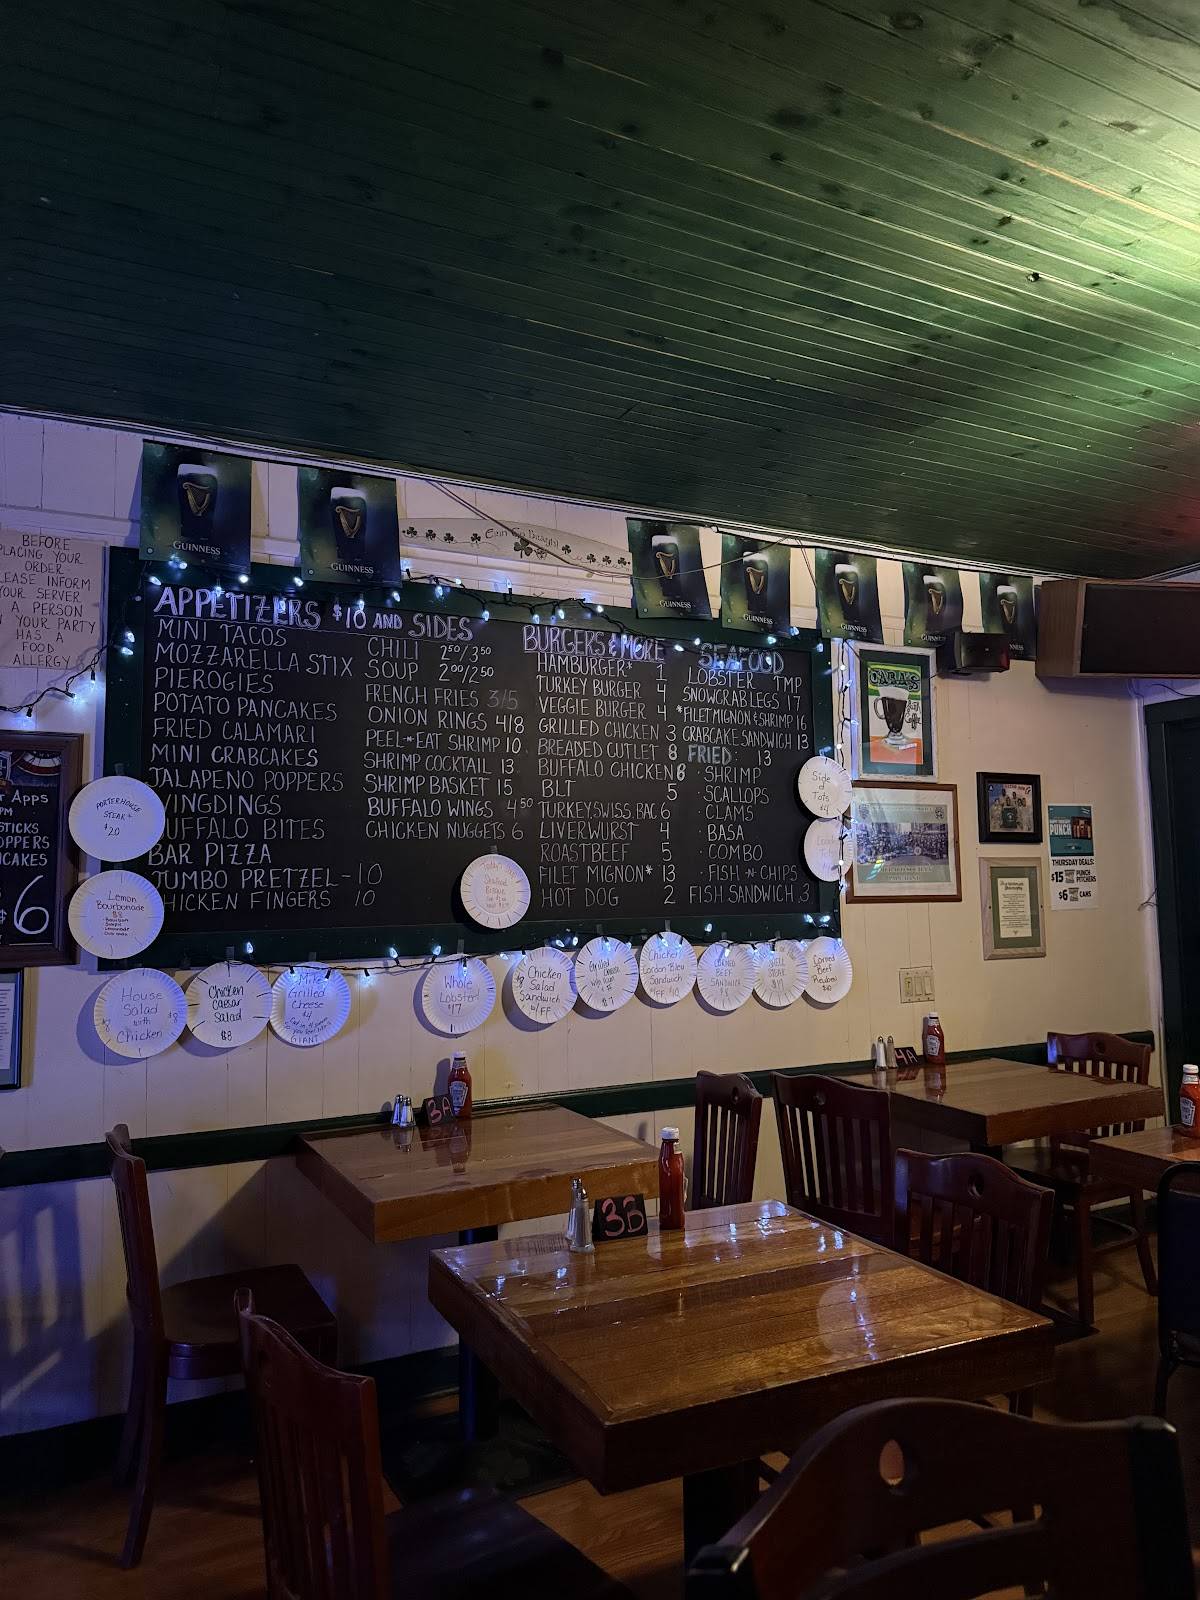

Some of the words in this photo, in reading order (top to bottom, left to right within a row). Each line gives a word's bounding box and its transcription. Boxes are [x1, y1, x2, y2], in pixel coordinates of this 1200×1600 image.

[22, 534, 71, 550] BEFORE
[172, 539, 221, 556] GUINNESS
[24, 560, 65, 575] ORDER
[53, 551, 84, 565] YOUR
[330, 562, 374, 575] GUINNESS
[47, 575, 91, 591] INFORM
[36, 588, 82, 603] SERVER
[659, 600, 692, 609] GUINNESS
[11, 601, 20, 613] A
[32, 601, 83, 618] PERSON
[153, 586, 321, 631] APPETIZERS
[372, 612, 403, 630] AND
[407, 612, 474, 642] SIDES
[15, 614, 51, 630] YOUR
[57, 618, 96, 635] PARTY
[742, 613, 774, 626] GUINNESS
[16, 629, 42, 641] HAS
[56, 632, 64, 643] A
[157, 619, 207, 642] MINI
[219, 623, 287, 647] TACOS
[522, 624, 606, 656] BURGERS
[22, 641, 55, 654] FOOD
[367, 636, 419, 660] CHILI
[12, 654, 71, 670] ALLERGY
[154, 641, 300, 673] MOZZARELLA
[305, 653, 353, 677] STIX
[364, 659, 419, 681] SOUP
[154, 667, 274, 694] PIEROGIES
[536, 674, 587, 696] TURKEY
[592, 679, 642, 699] BURGER
[656, 683, 666, 703] 4
[687, 666, 756, 690] LOBSTER
[773, 675, 803, 694] TMP
[365, 683, 427, 704] FRENCH
[434, 687, 479, 708] FRIES
[787, 695, 801, 711] 17
[153, 692, 230, 715] POTATO
[237, 697, 337, 722] PANCAKES
[538, 696, 590, 716] VEGGIE
[595, 699, 647, 720] BURGER
[657, 704, 667, 721] 4
[367, 706, 428, 726] ONION
[437, 710, 488, 731] RINGS
[713, 708, 751, 725] MIGNON
[759, 712, 793, 728] SHRIMP
[796, 714, 807, 731] 16
[152, 718, 212, 739] FRIED
[222, 721, 315, 743] CALAMARI
[538, 718, 600, 736] GRILLED
[604, 720, 660, 740] CHICKEN
[665, 724, 677, 742] 3
[682, 725, 738, 747] CRABCAKE
[740, 729, 792, 751] SANDWICH
[797, 734, 809, 750] 13
[447, 733, 501, 753] SHRIMP
[506, 736, 521, 754] 10
[537, 738, 603, 758] BREADED
[606, 742, 659, 761] CUTLET
[668, 743, 678, 760] 8
[150, 743, 200, 763] MINI
[211, 745, 319, 767] CRABCAKES
[363, 751, 421, 771] SHRIMP
[425, 756, 492, 775] COCKTAIL
[501, 758, 514, 775] 13
[757, 749, 772, 766] 13
[538, 757, 604, 777] BUFFALO
[610, 761, 674, 781] CHICKEN
[703, 765, 762, 784] SHRIMP
[146, 767, 254, 789] JALAPENO
[264, 770, 344, 792] POPPERS
[362, 773, 425, 795] SHRIMP
[429, 775, 491, 797] BASKET
[497, 778, 513, 796] 15
[12, 789, 49, 807] Apps
[541, 779, 577, 798] BLT
[666, 782, 678, 801] 5
[703, 785, 770, 805] SCALLOPS
[96, 797, 143, 813] PORTERHOUSE
[367, 797, 441, 817] BUFFALO
[449, 800, 494, 818] WINGS
[660, 802, 671, 819] 6
[705, 803, 754, 822] CLAMS
[103, 810, 126, 821] STEAK
[103, 823, 120, 837] $20
[162, 816, 249, 840] UFFALO
[263, 818, 326, 840] BITES
[365, 820, 439, 840] CHICKEN
[447, 821, 505, 840] NUGGETS
[511, 822, 524, 840] 6
[539, 821, 640, 841] LIVERWURST
[660, 821, 670, 840] 4
[707, 823, 745, 842] BASA
[147, 842, 193, 866] BAR
[205, 842, 272, 867] PIZZA
[661, 842, 672, 862] 5
[708, 843, 763, 862] COMBO
[151, 870, 228, 890] JUMBO
[241, 867, 339, 890] PRETZEL
[539, 866, 579, 885] FILET
[662, 864, 676, 883] 13
[708, 864, 740, 882] FISH
[760, 864, 798, 882] CHIPS
[1051, 871, 1064, 883] $15
[108, 889, 137, 904] Lemon
[163, 892, 238, 911] HICKEN
[250, 890, 331, 911] FINGERS
[354, 890, 376, 907] 10
[541, 887, 577, 908] HOT
[584, 887, 620, 907] DOG
[663, 885, 676, 905] 2
[689, 885, 723, 904] FISH
[728, 884, 794, 904] SANDWICH
[799, 883, 810, 902] 3
[1058, 889, 1068, 901] $6
[527, 965, 562, 980] Chicken
[208, 984, 244, 1000] Chicken
[444, 975, 473, 990] Whole
[530, 979, 556, 992] Salad
[121, 986, 163, 1002] House
[519, 989, 562, 1003] Sandwich
[123, 1003, 158, 1017] Salad
[291, 1000, 324, 1009] Cheese
[214, 1010, 242, 1024] Salad
[116, 1029, 163, 1044] Chicken
